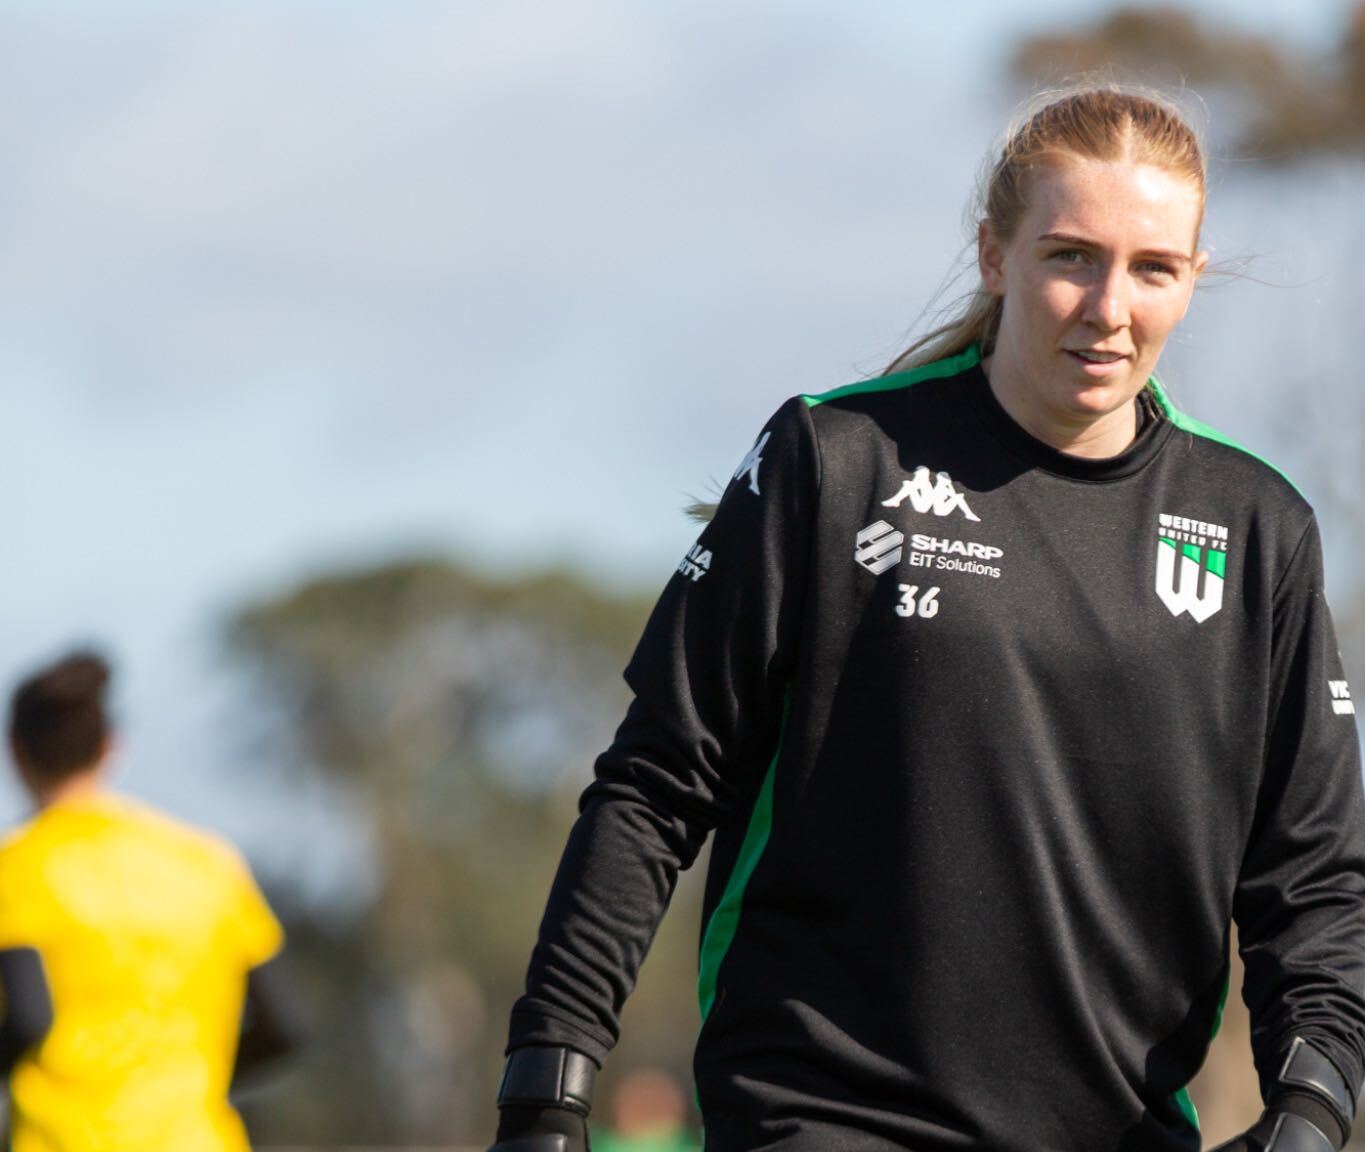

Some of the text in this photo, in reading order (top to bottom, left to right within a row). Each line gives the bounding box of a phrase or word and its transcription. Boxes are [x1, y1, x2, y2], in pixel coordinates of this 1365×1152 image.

[1159, 513, 1228, 540] WESTERN
[910, 534, 1004, 560] SHARP
[909, 551, 1002, 578] EIT Solutions
[895, 583, 941, 619] 36
